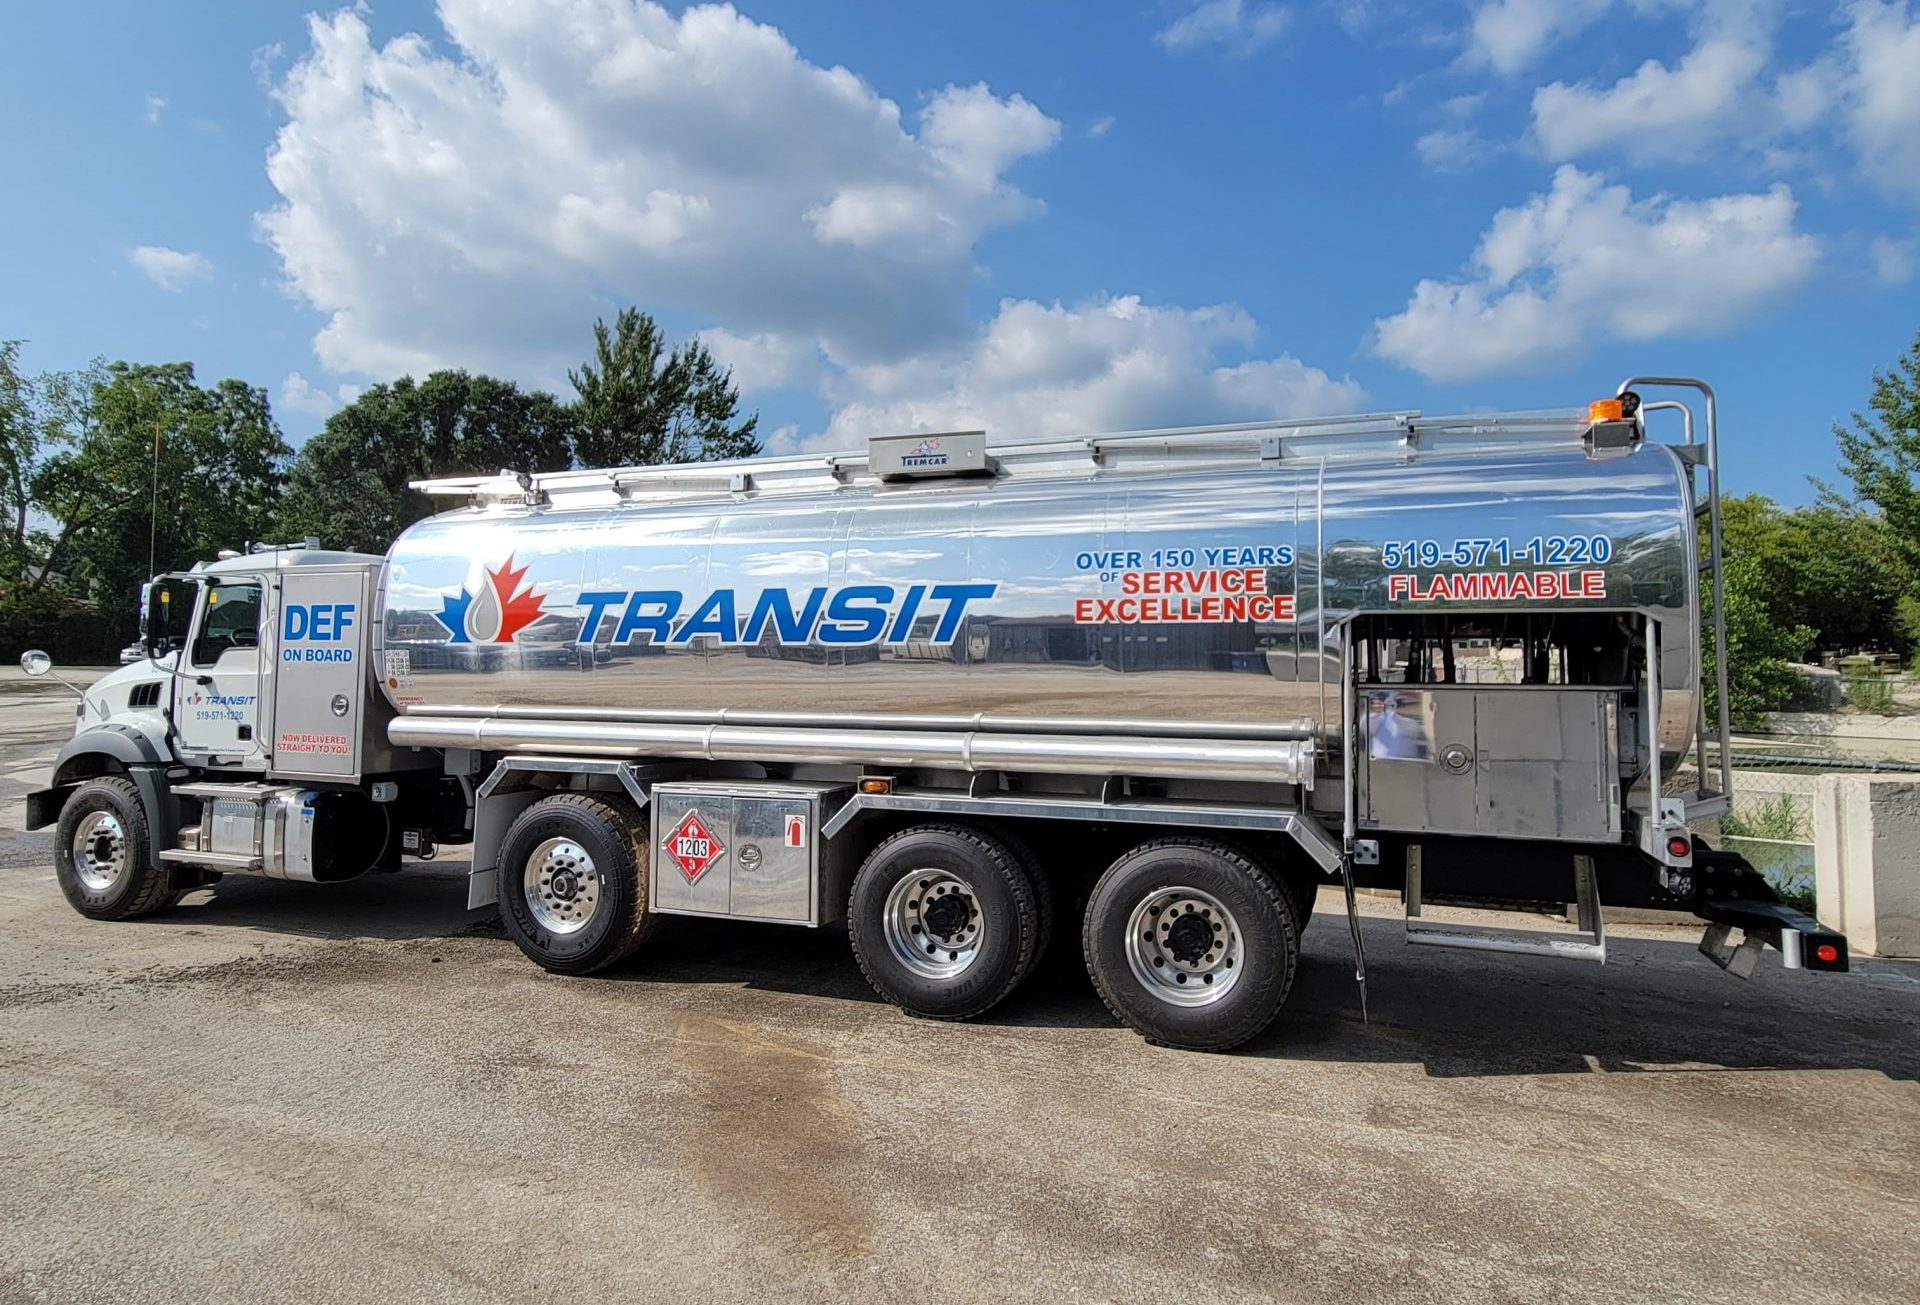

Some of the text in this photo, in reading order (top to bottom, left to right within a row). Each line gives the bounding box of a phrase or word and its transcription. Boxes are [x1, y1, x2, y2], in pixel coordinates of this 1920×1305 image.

[901, 454, 947, 466] TREMCAR
[1075, 547, 1293, 569] OVER 150 YEARS
[1384, 537, 1611, 567] 519-571-1220
[1100, 572, 1119, 582] OF
[1123, 571, 1264, 594] SERVICE
[1390, 573, 1605, 599] FLAMMABLE
[578, 585, 996, 643] TRANSIT
[1076, 596, 1294, 621] EXCELLENCE
[284, 604, 355, 641] DEF
[283, 649, 352, 662] ON BOARD
[206, 696, 256, 705] TRANSIT
[196, 711, 244, 720] 519-571-1220
[282, 734, 347, 744] NOW DELIVERED
[277, 743, 316, 752] STRAIGHT
[320, 745, 330, 753] TO
[678, 838, 708, 857] 1203
[689, 859, 696, 870] 3
